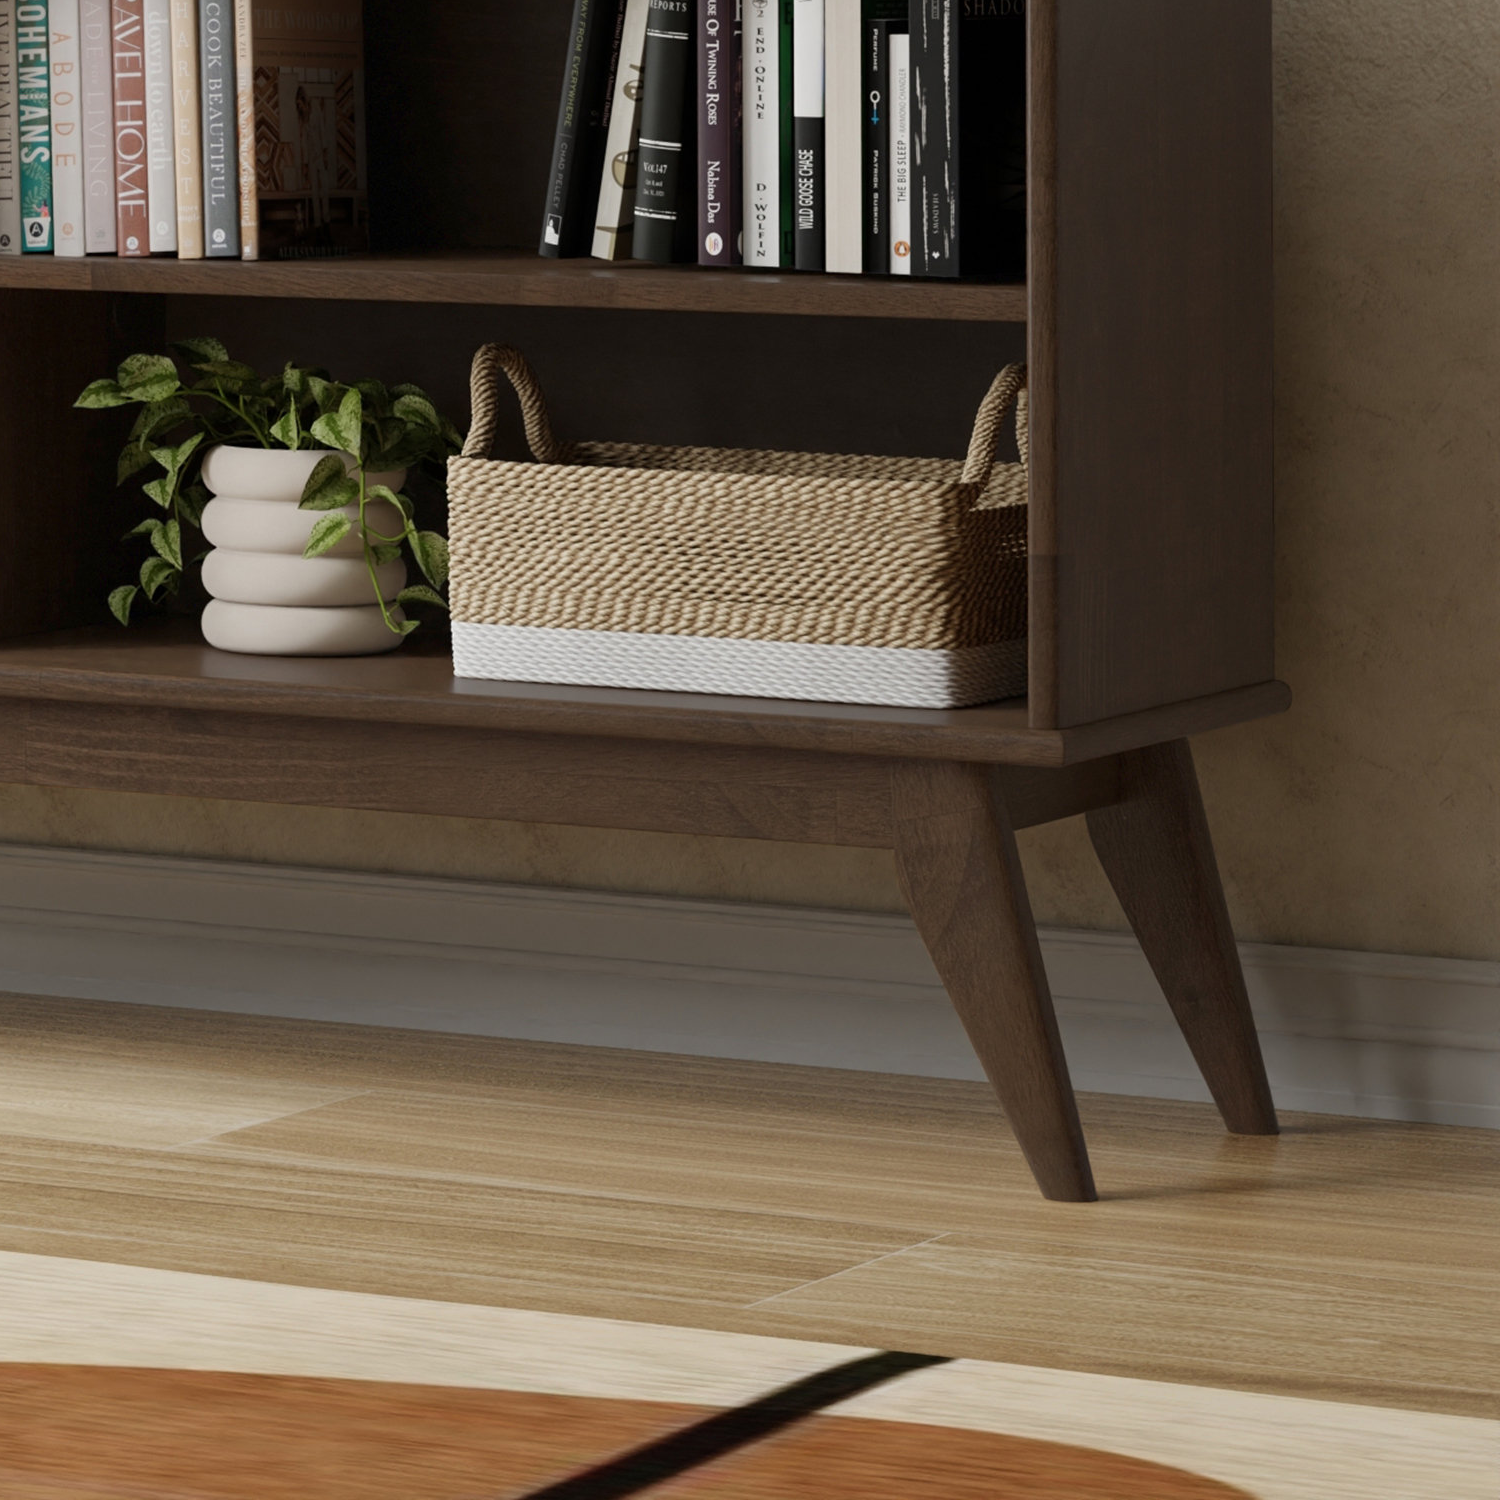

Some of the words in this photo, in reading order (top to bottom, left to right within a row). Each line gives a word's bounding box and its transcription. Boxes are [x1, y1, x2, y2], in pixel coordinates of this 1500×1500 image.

[254, 8, 281, 29] THE
[705, 19, 719, 36] OF
[149, 11, 168, 74] down
[205, 2, 222, 69] COOK
[576, 20, 586, 52] FROM
[755, 27, 765, 54] END
[705, 40, 719, 90] TWINING
[51, 31, 76, 167] ABODE
[150, 83, 168, 104] to
[176, 2, 192, 195] HARVEST
[563, 55, 581, 128] EVERYWHERE
[754, 66, 766, 120] ONLINE
[898, 68, 907, 100] CHANDLER
[705, 93, 719, 125] ROSES
[898, 101, 907, 134] RAYMOND
[87, 92, 109, 197] LIVING
[150, 108, 172, 171] earth
[207, 78, 226, 205] BEAUTIFUL
[559, 141, 568, 170] CHAD
[897, 139, 907, 166] SLEEP
[115, 99, 147, 219] HOME
[798, 149, 814, 177] CHASE
[552, 172, 564, 209] PELLEY
[707, 160, 720, 200] Nabina
[798, 177, 814, 206] GOOSE
[897, 167, 907, 184] BIG
[897, 186, 907, 202] THE
[707, 202, 721, 224] Das
[798, 207, 814, 230] WILD
[932, 192, 940, 234] SHADOWS
